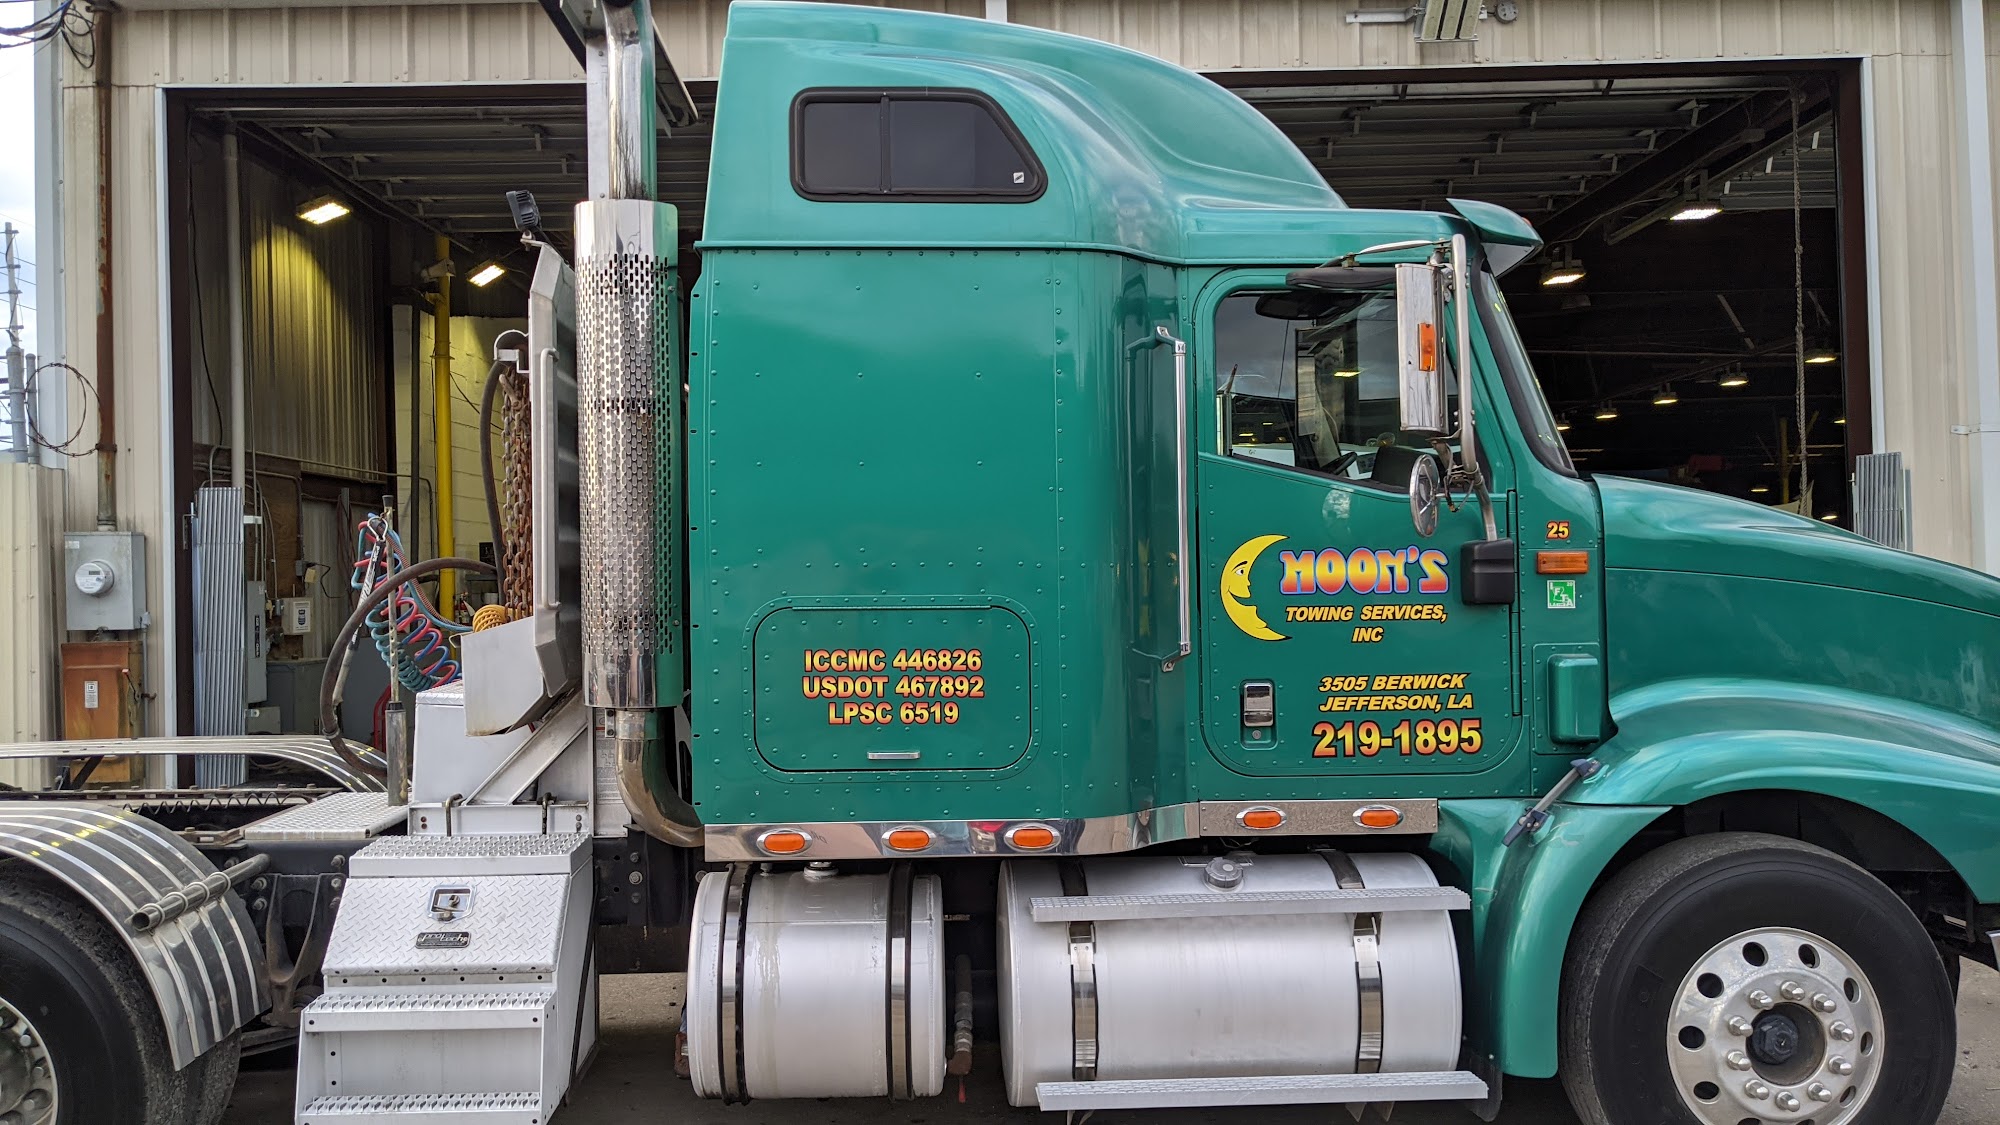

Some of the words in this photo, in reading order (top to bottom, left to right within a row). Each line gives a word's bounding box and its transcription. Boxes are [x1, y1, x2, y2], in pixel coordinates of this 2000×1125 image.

[1547, 521, 1569, 539] 25
[1280, 545, 1449, 595] MOON'S
[1286, 606, 1353, 622] TOWING
[1360, 605, 1448, 623] SERVICES,
[1351, 627, 1384, 643] INC
[804, 649, 886, 672] ICCMC
[892, 649, 982, 671] 446826
[802, 676, 889, 698] USDOT
[895, 676, 985, 698] 467892
[1318, 676, 1369, 692] 3505
[1371, 673, 1469, 691] BERWICK
[828, 702, 893, 724] LPSC
[899, 702, 959, 724] 6519
[1319, 695, 1442, 713] JEFFERSON,
[1446, 694, 1473, 709] LA
[1312, 718, 1482, 757] 219-1895
